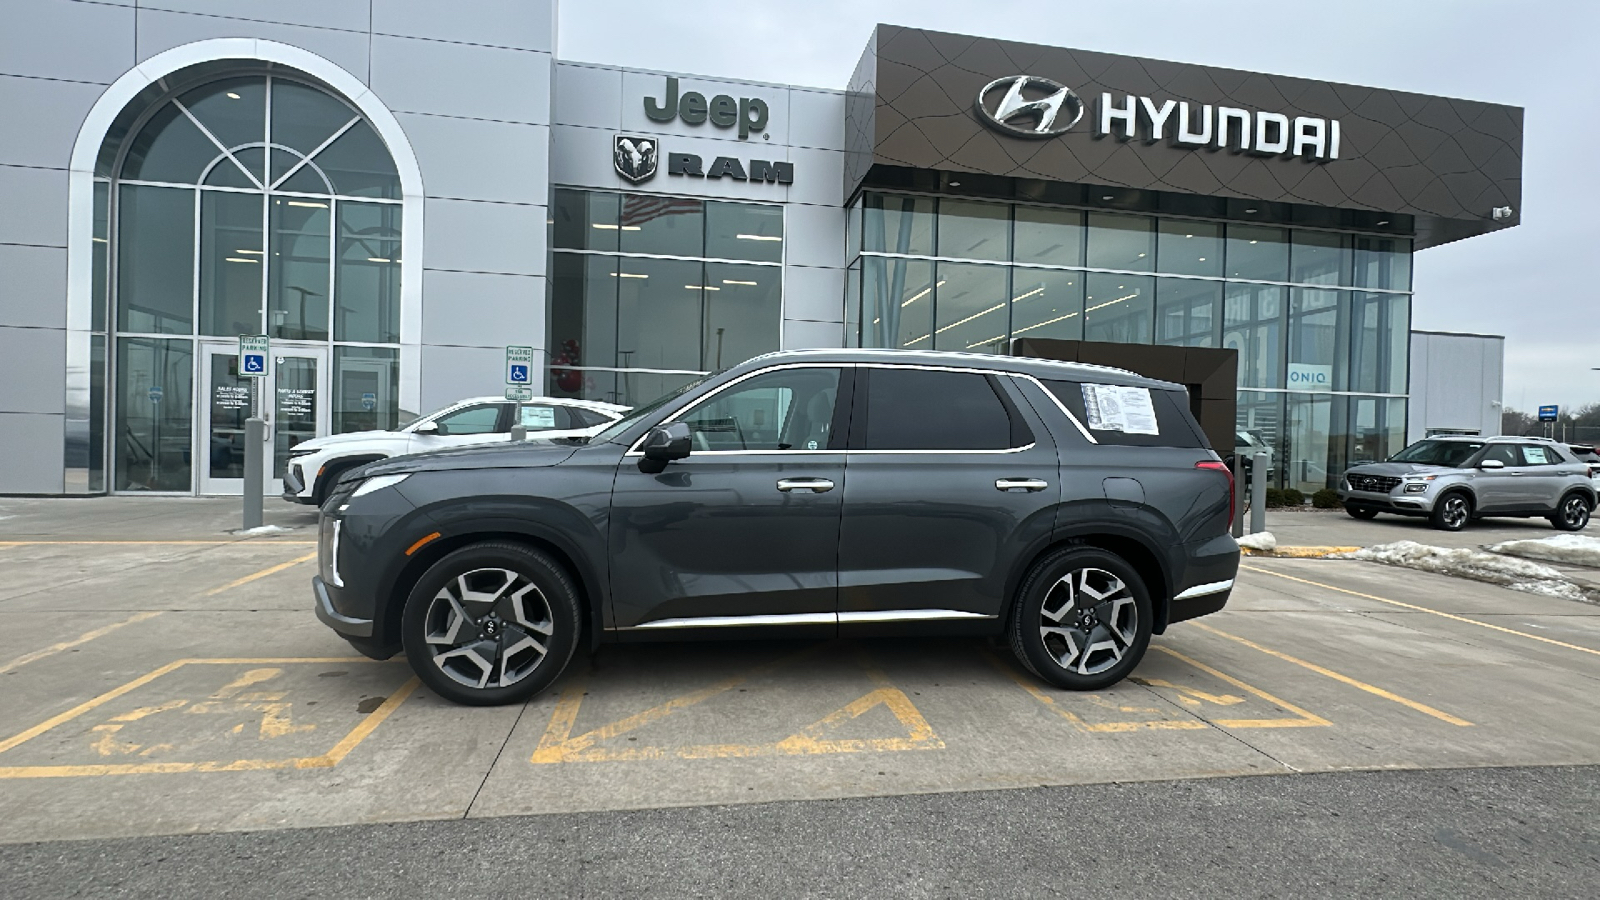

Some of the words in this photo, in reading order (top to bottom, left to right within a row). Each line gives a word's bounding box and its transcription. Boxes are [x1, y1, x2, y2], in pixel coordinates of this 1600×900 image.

[644, 77, 769, 139] Jeep
[1098, 92, 1341, 160] HYUNDAI
[668, 152, 794, 185] RAM
